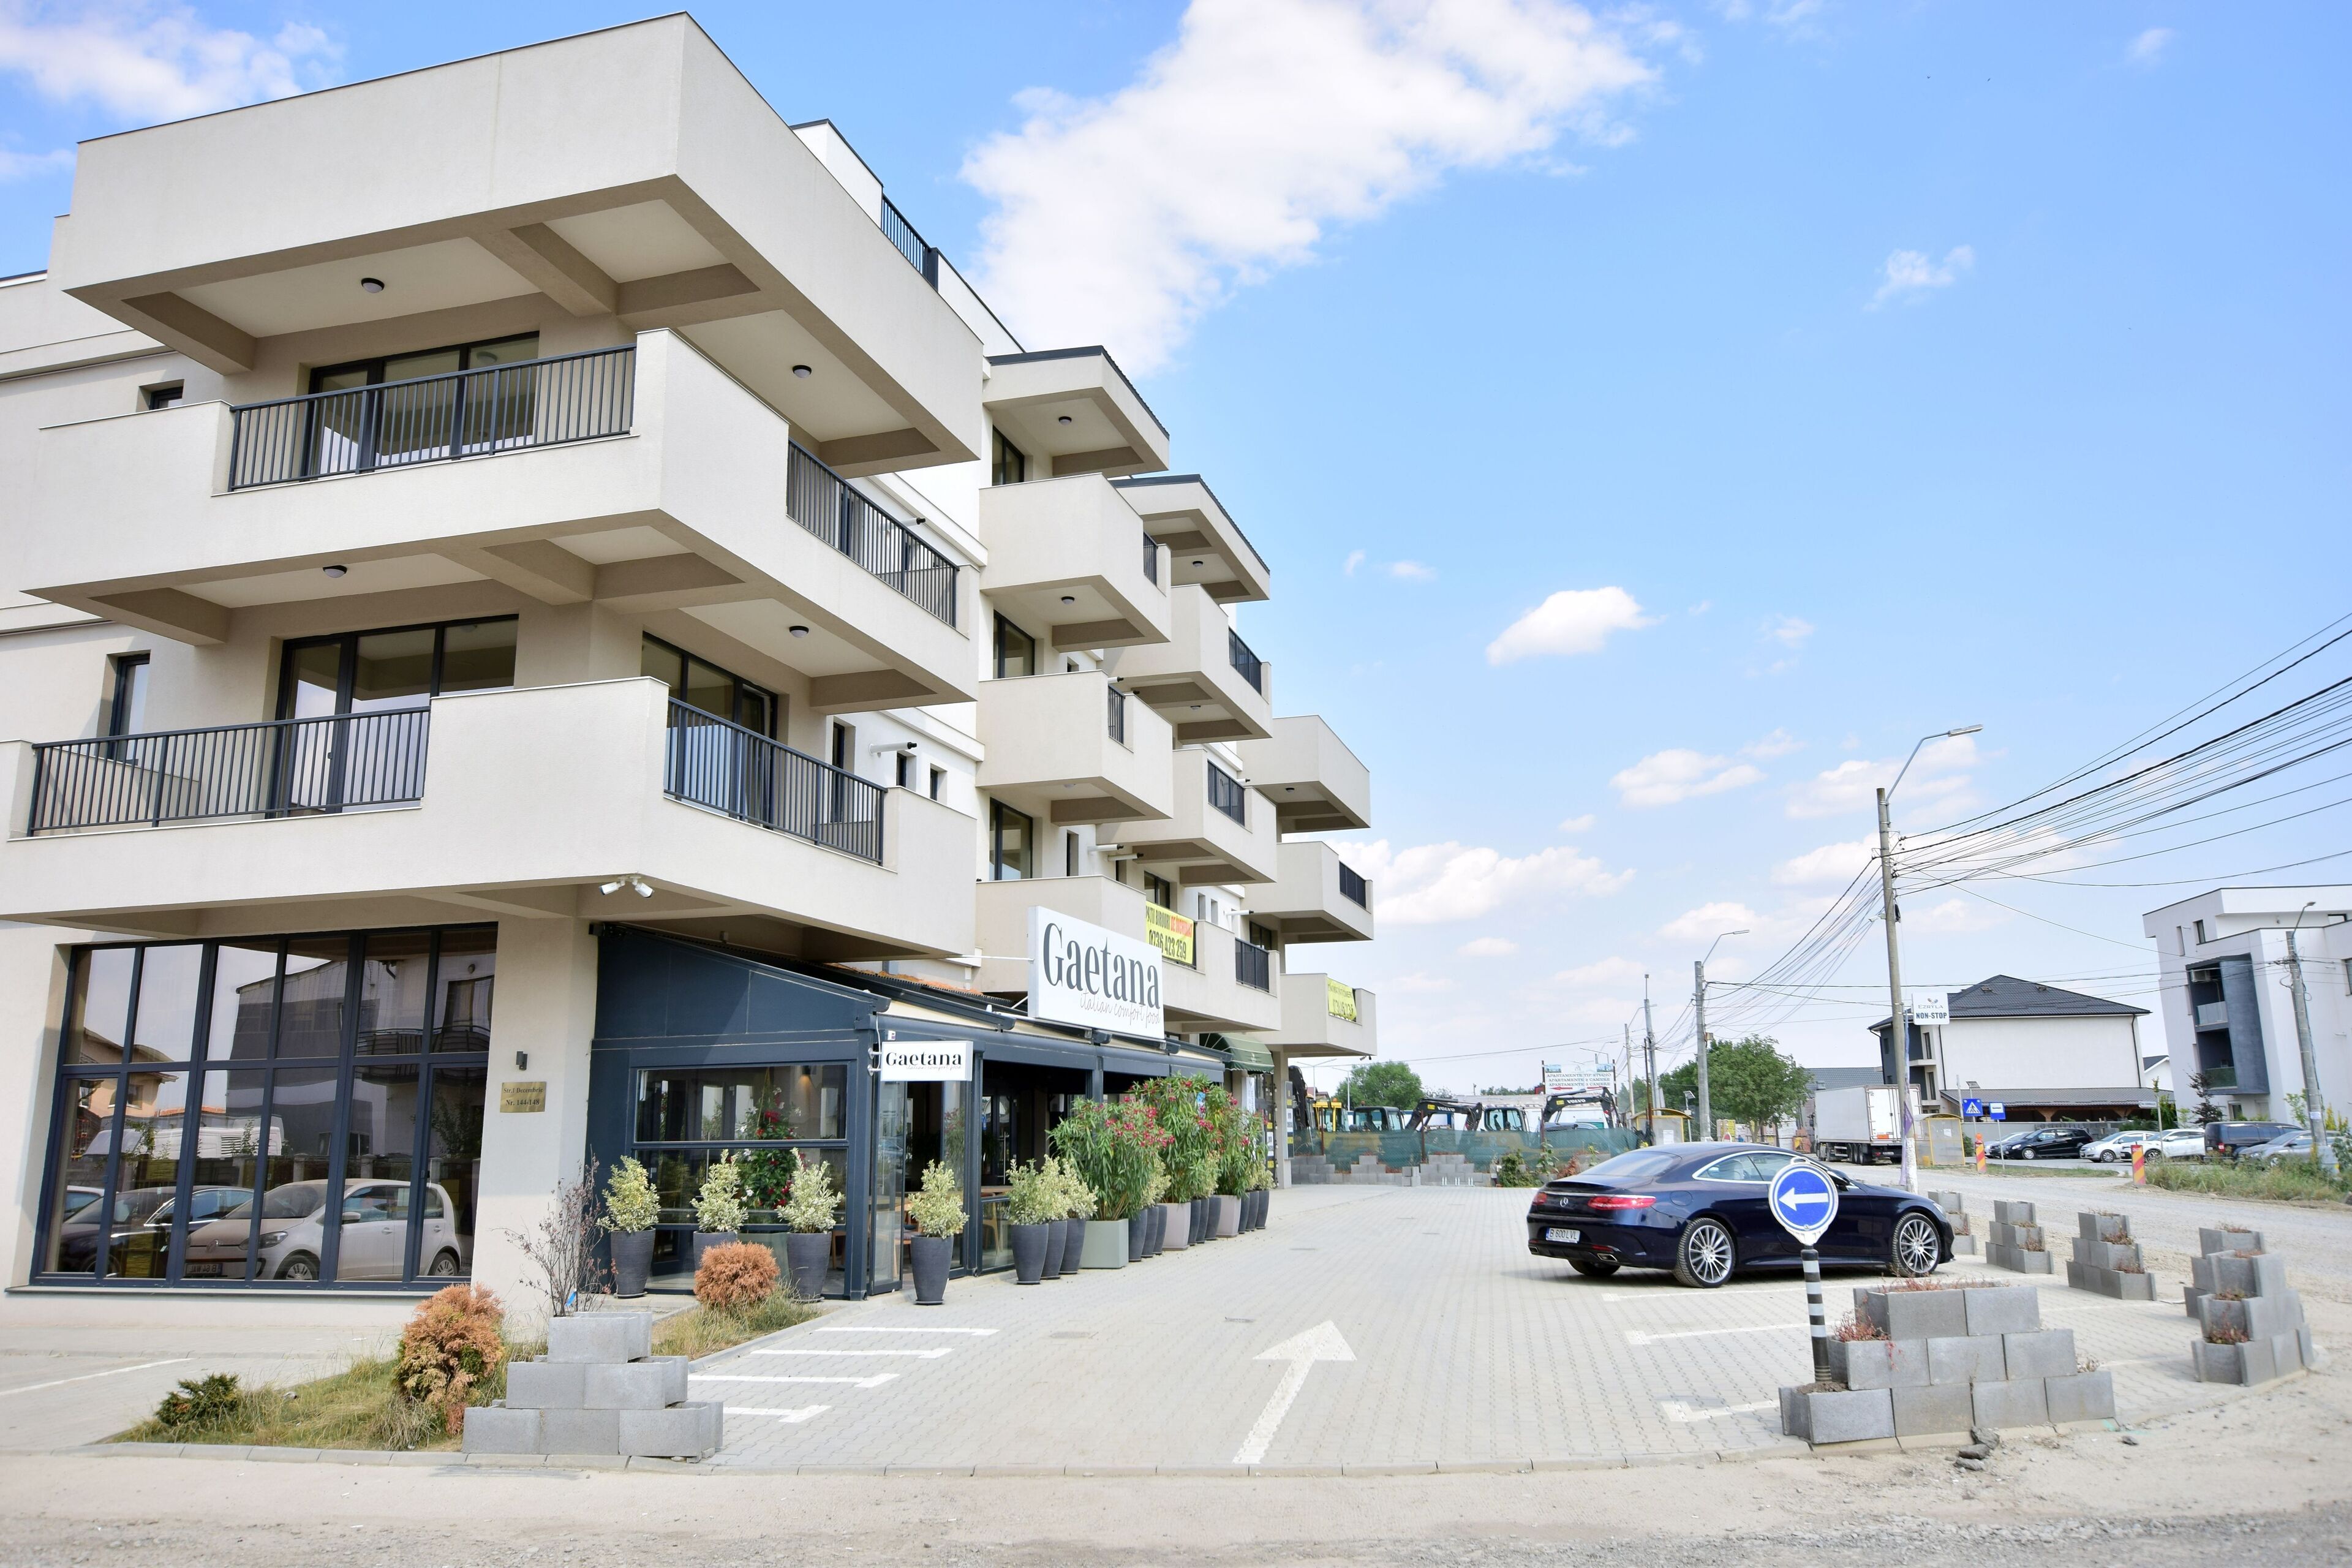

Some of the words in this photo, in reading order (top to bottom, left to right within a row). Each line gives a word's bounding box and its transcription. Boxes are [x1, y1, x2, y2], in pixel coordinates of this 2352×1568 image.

[1149, 929, 1163, 953] 0736
[1164, 935, 1175, 957] 423
[1176, 939, 1186, 960] 259
[1043, 922, 1160, 1009] Gaetana
[1080, 988, 1112, 1014] italian
[1114, 1003, 1145, 1026] comfort
[1145, 1006, 1161, 1028] food
[886, 1052, 962, 1066] Gaetana
[1550, 1229, 1554, 1237] B
[1555, 1229, 1566, 1238] 600
[1566, 1230, 1577, 1240] LVL
